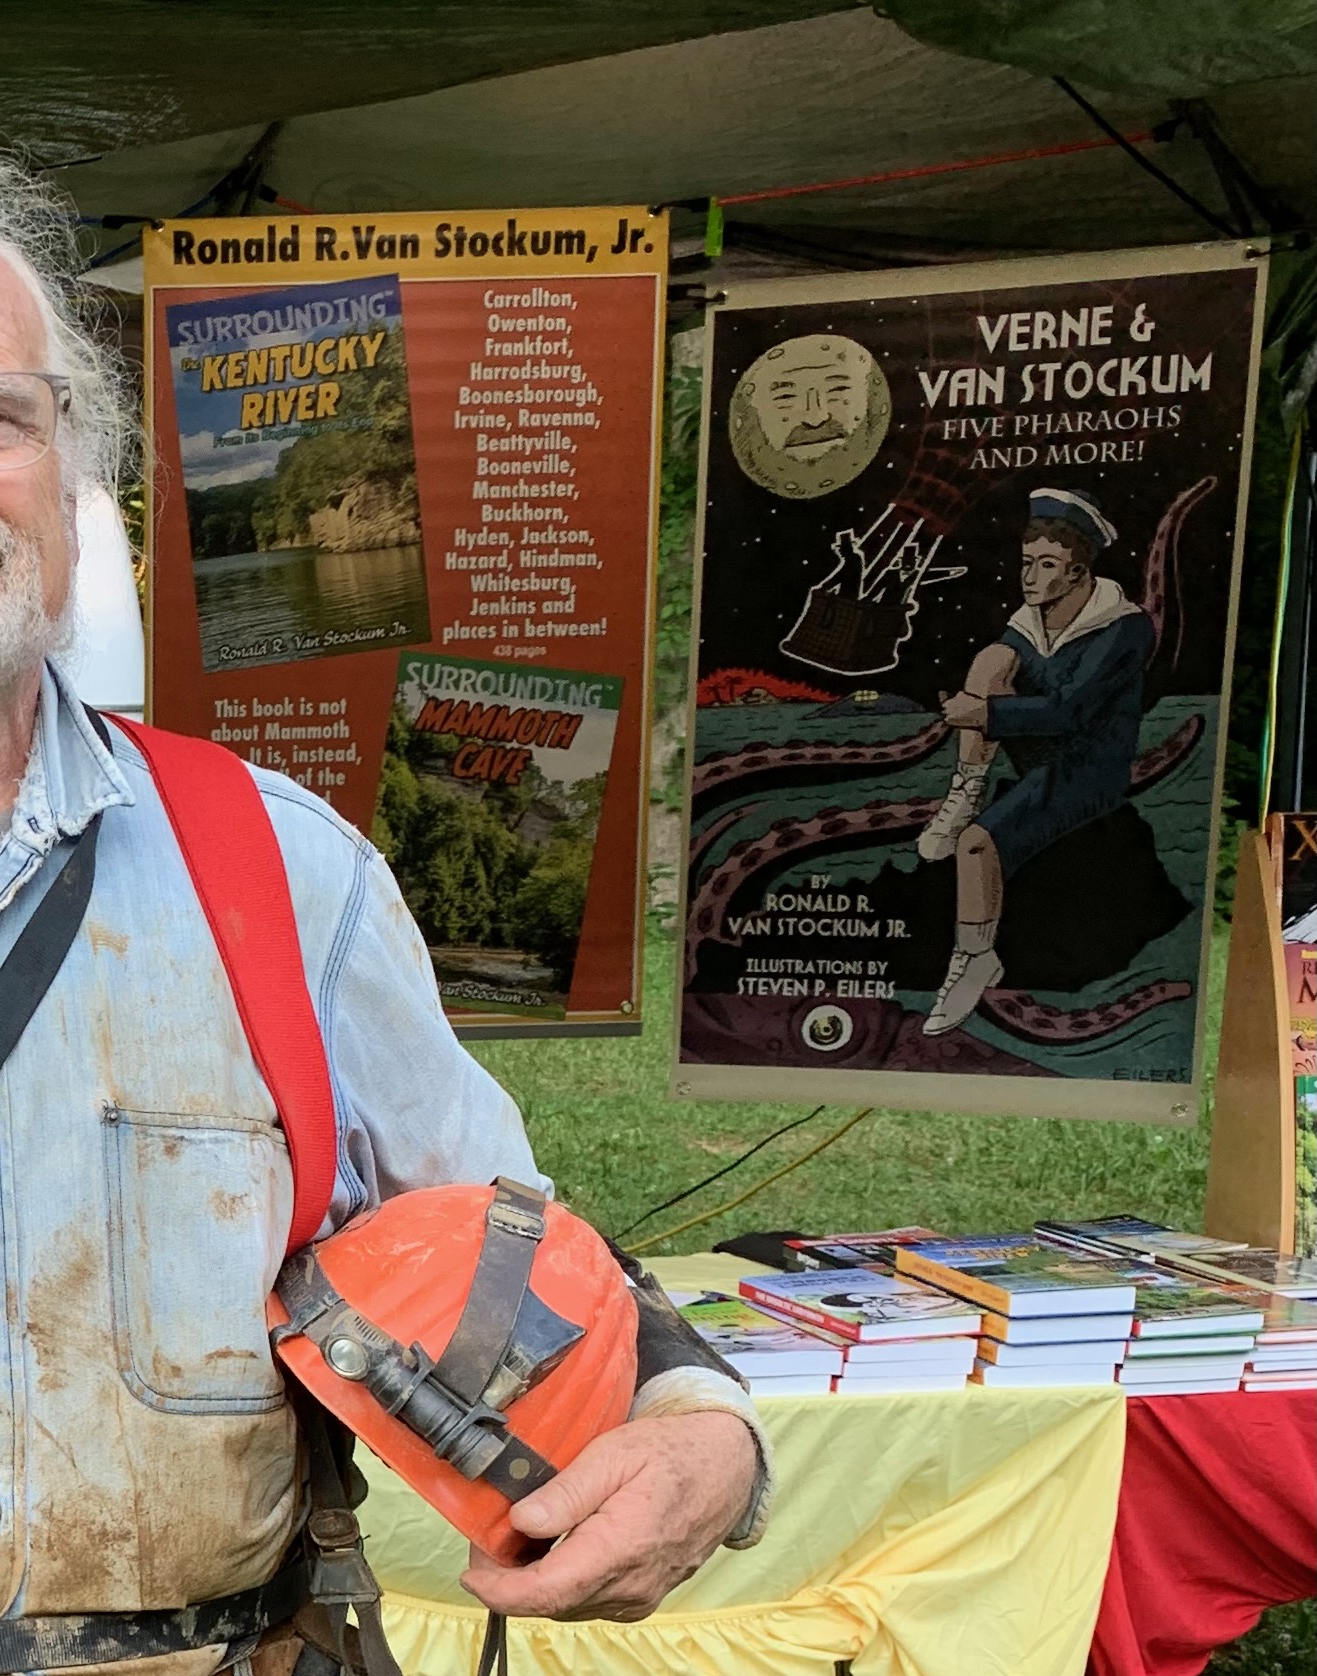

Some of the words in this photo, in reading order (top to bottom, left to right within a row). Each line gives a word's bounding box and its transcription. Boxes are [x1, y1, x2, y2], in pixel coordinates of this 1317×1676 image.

[173, 224, 300, 265] Ronald
[435, 218, 598, 263] Stockum,
[611, 218, 654, 254] Jr.
[484, 287, 578, 310] Carrollton,
[488, 313, 573, 335] Owenton,
[977, 305, 1114, 353] VERNE
[1129, 302, 1156, 343] &
[485, 335, 574, 358] Frankfort,
[200, 331, 386, 394] KENTUCKY
[469, 359, 587, 384] Harrodsburg,
[918, 366, 1006, 409] VAN
[1020, 352, 1214, 404] STOCKUM
[239, 380, 342, 431] RIVER
[458, 381, 604, 408] Boonesborough,
[453, 409, 513, 432] Irvine,
[518, 408, 602, 430] Ravenna,
[942, 416, 1005, 440] FIVE
[1013, 404, 1182, 437] PHARAOHS
[476, 430, 578, 455] Beattyville,
[476, 453, 577, 477] Booneville,
[969, 446, 1038, 470] AND
[1043, 440, 1145, 467] MORE!
[473, 478, 580, 501] Manchester,
[481, 502, 570, 524] Buckhorn,
[454, 526, 515, 551] Hyden,
[520, 524, 596, 547] Jackson,
[445, 549, 514, 572] Hazard,
[519, 548, 604, 570] Hindman,
[470, 572, 577, 596] Whitesburg,
[469, 596, 537, 616] Jenkins
[541, 594, 576, 614] and
[442, 620, 497, 644] places
[501, 619, 519, 638] in
[524, 617, 608, 638] between!
[219, 643, 268, 662] Ronald
[293, 633, 321, 650] Van
[323, 627, 386, 646] Stockum
[514, 645, 547, 659] pages
[406, 661, 602, 709] SURROUNDING
[214, 698, 248, 718] This
[252, 697, 295, 717] book
[299, 697, 314, 716] is
[318, 698, 347, 716] not
[210, 722, 259, 742] about
[264, 719, 351, 741] Mammoth
[413, 696, 584, 750] MAMMOTH
[249, 746, 262, 765] It
[267, 745, 287, 767] is,
[292, 742, 363, 766] instead,
[452, 741, 533, 786] CAVE
[317, 768, 346, 786] the
[810, 874, 832, 890] BY
[765, 893, 851, 913] RONALD
[856, 894, 875, 914] R.
[727, 917, 772, 936] VAN
[777, 918, 880, 938] STOCKUM
[885, 919, 913, 939] JR.
[745, 958, 864, 975] ILLUSTRATIONS
[867, 960, 889, 976] BY
[736, 977, 809, 997] STEVEN
[813, 978, 831, 998] P.
[836, 979, 896, 999] EILERS
